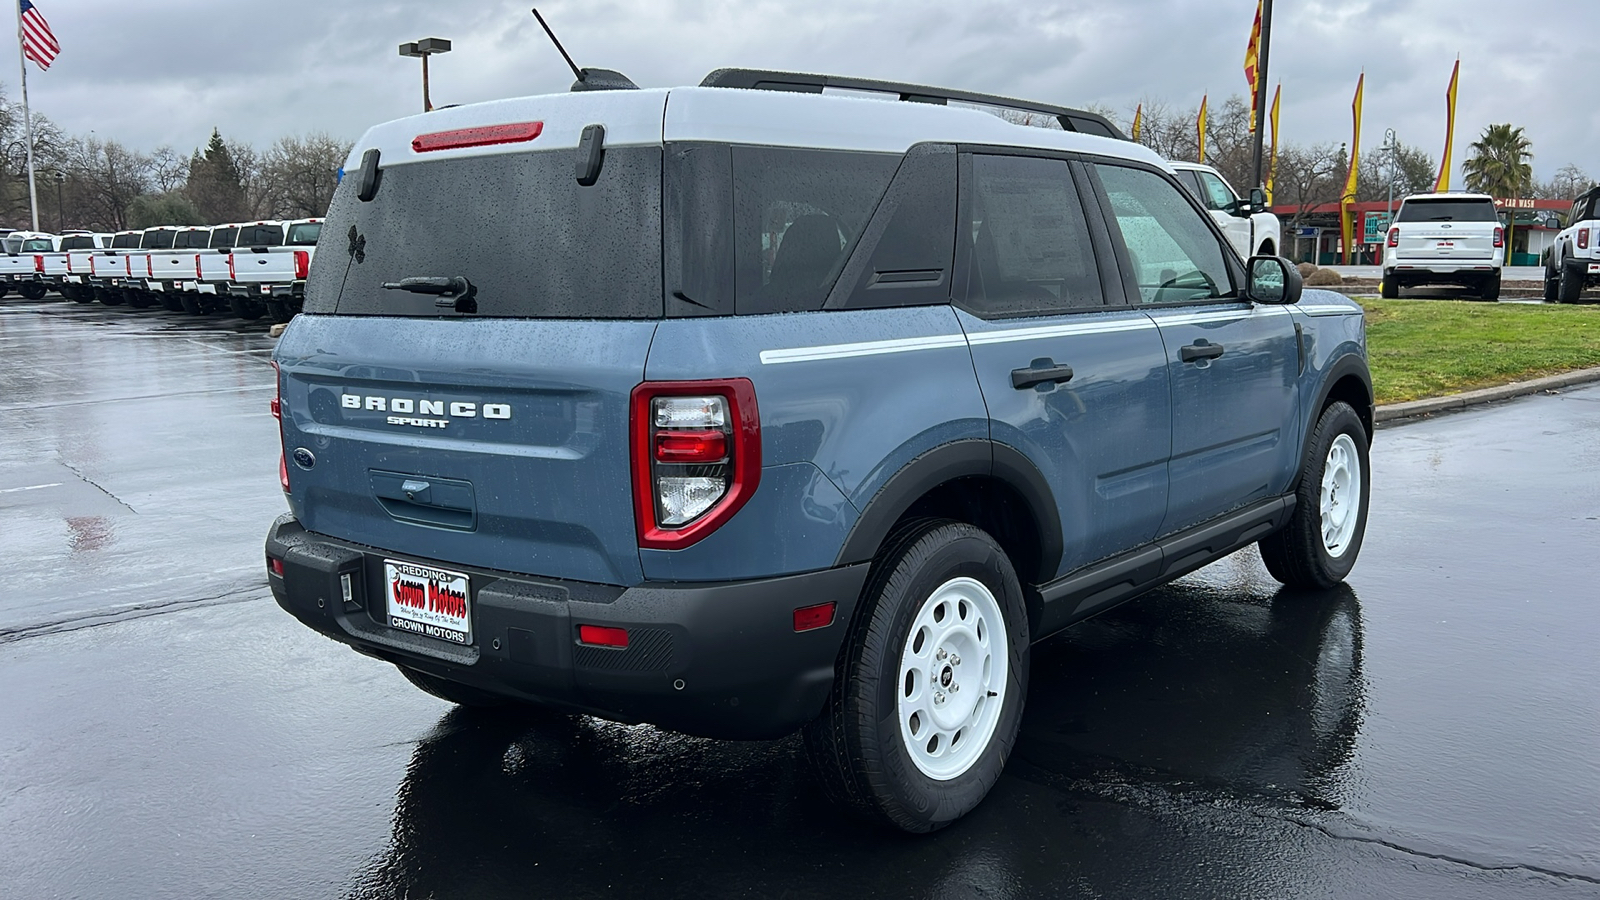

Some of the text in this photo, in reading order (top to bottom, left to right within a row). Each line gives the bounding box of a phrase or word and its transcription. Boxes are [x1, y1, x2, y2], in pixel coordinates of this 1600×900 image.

[1504, 198, 1535, 208] CAR WASH
[341, 393, 511, 419] BRONCO
[387, 416, 449, 428] SPORT
[402, 565, 446, 581] REDDING
[393, 578, 467, 619] Crown Motors
[392, 617, 464, 642] CROWN MOTORS
